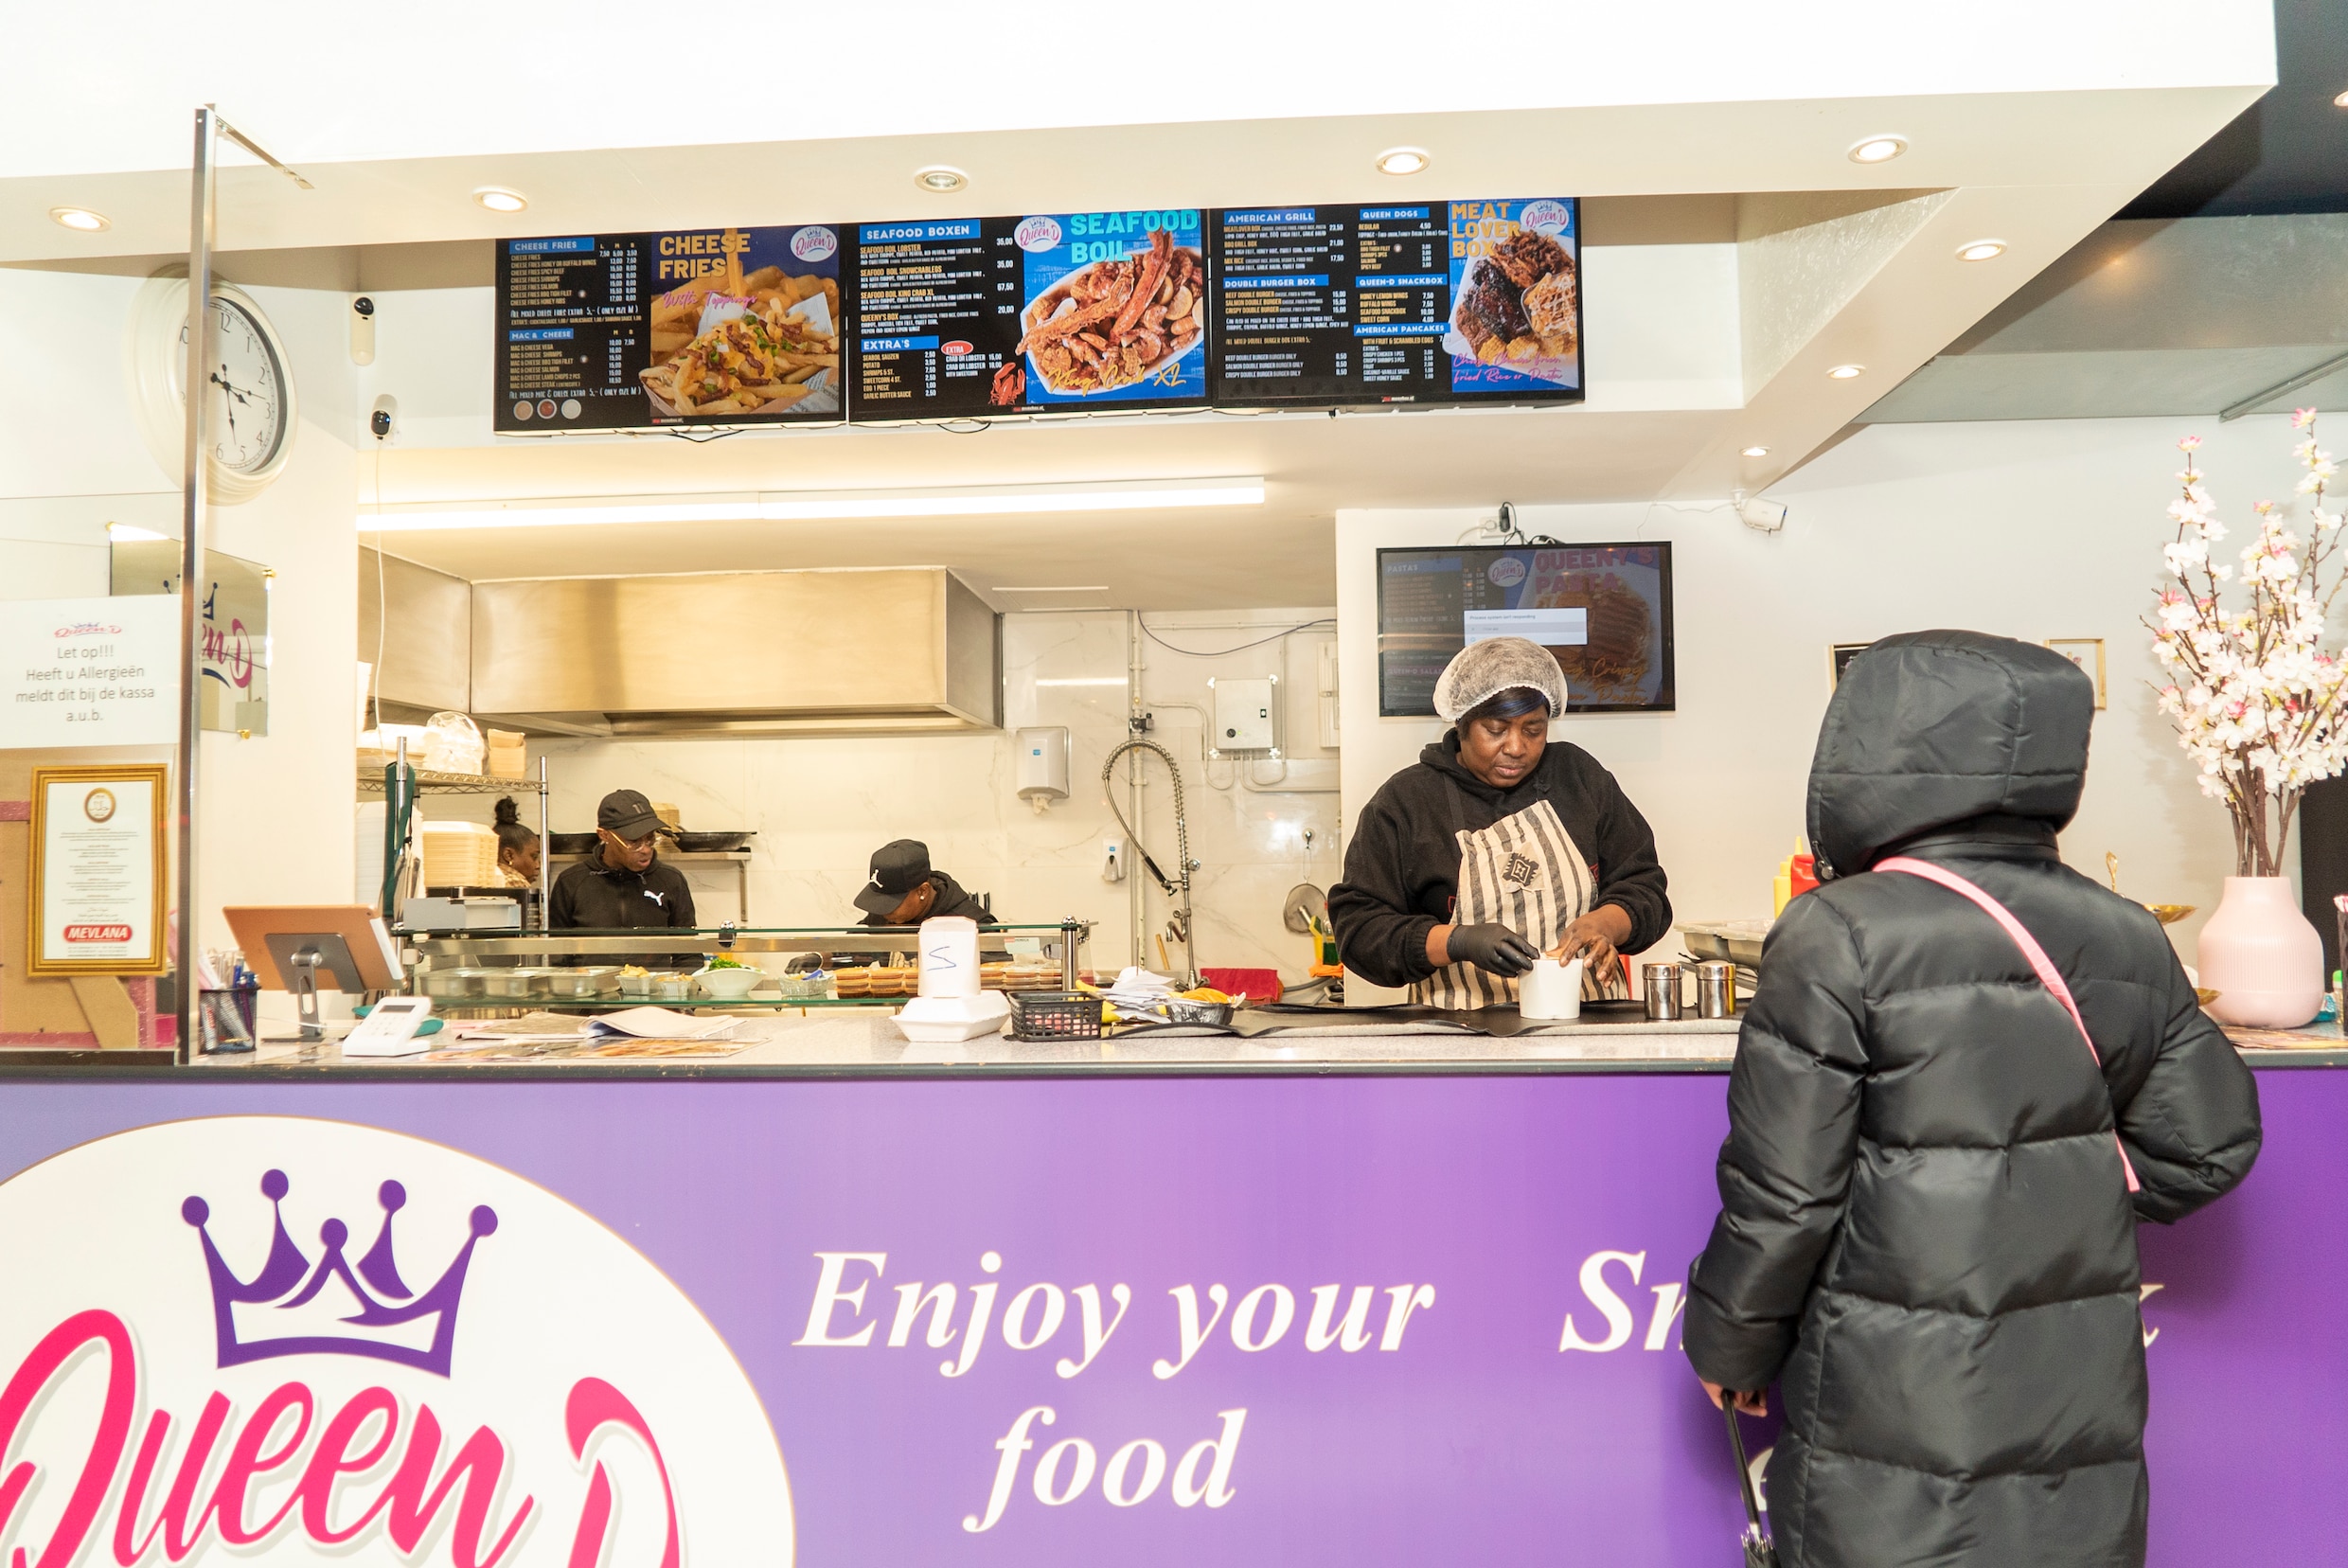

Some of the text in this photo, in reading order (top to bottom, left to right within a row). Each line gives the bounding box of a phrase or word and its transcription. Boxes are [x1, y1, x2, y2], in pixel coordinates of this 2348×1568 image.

[1228, 212, 1314, 223] AMERICAN GRILL
[1451, 202, 1511, 220] MEAT
[1526, 211, 1556, 227] Queen
[1071, 209, 1198, 236] SEAFOOD
[1451, 221, 1521, 239] LOVER
[866, 225, 969, 240] SEAFOOD BOXEN
[1020, 227, 1050, 247] Queen
[514, 241, 578, 251] CHEESE FRIES
[659, 233, 751, 256] CHEESE
[795, 237, 825, 256] Queen
[898, 243, 921, 252] LOBSTER
[1071, 240, 1132, 264] BOIL
[1452, 240, 1496, 258] BOX
[659, 258, 726, 279] FRIES
[860, 265, 942, 276] SEAFOOD BOIL SNOWCRABLEGS
[1225, 279, 1258, 288] DOUBLE
[1261, 278, 1294, 287] BURGER
[663, 290, 757, 311] With Toppings
[861, 291, 884, 299] SEAFOOD
[885, 290, 898, 298] BOIL
[898, 289, 911, 297] KING
[927, 288, 934, 296] XL
[220, 312, 230, 333] 12
[861, 313, 886, 322] QUEENY'S
[887, 312, 898, 321] BOX
[543, 330, 571, 339] CHEESE
[246, 336, 251, 353] 1
[863, 340, 910, 350] EXTRA'S
[946, 346, 964, 354] EXTRA
[258, 366, 266, 385] 2
[1046, 363, 1186, 397] King Crab XL
[264, 402, 272, 419] 3
[256, 430, 263, 446] 4
[216, 442, 224, 460] 6
[240, 445, 246, 461] 5
[1535, 546, 1654, 573] QUEENY'S
[1536, 572, 1619, 594] PASTA
[54, 626, 105, 638] Queen
[57, 645, 114, 661] Let op!!!
[230, 618, 253, 688] D
[27, 666, 145, 681] Heeft u Allergieën
[15, 686, 155, 703] meldt dit bij de kassa
[66, 708, 104, 722] a.u.b.
[67, 927, 128, 939] MEVLANA
[791, 1250, 1131, 1379] Enjoy
[1152, 1283, 1436, 1380] your
[0, 1309, 534, 1568] Queen
[961, 1405, 1248, 1533] food
